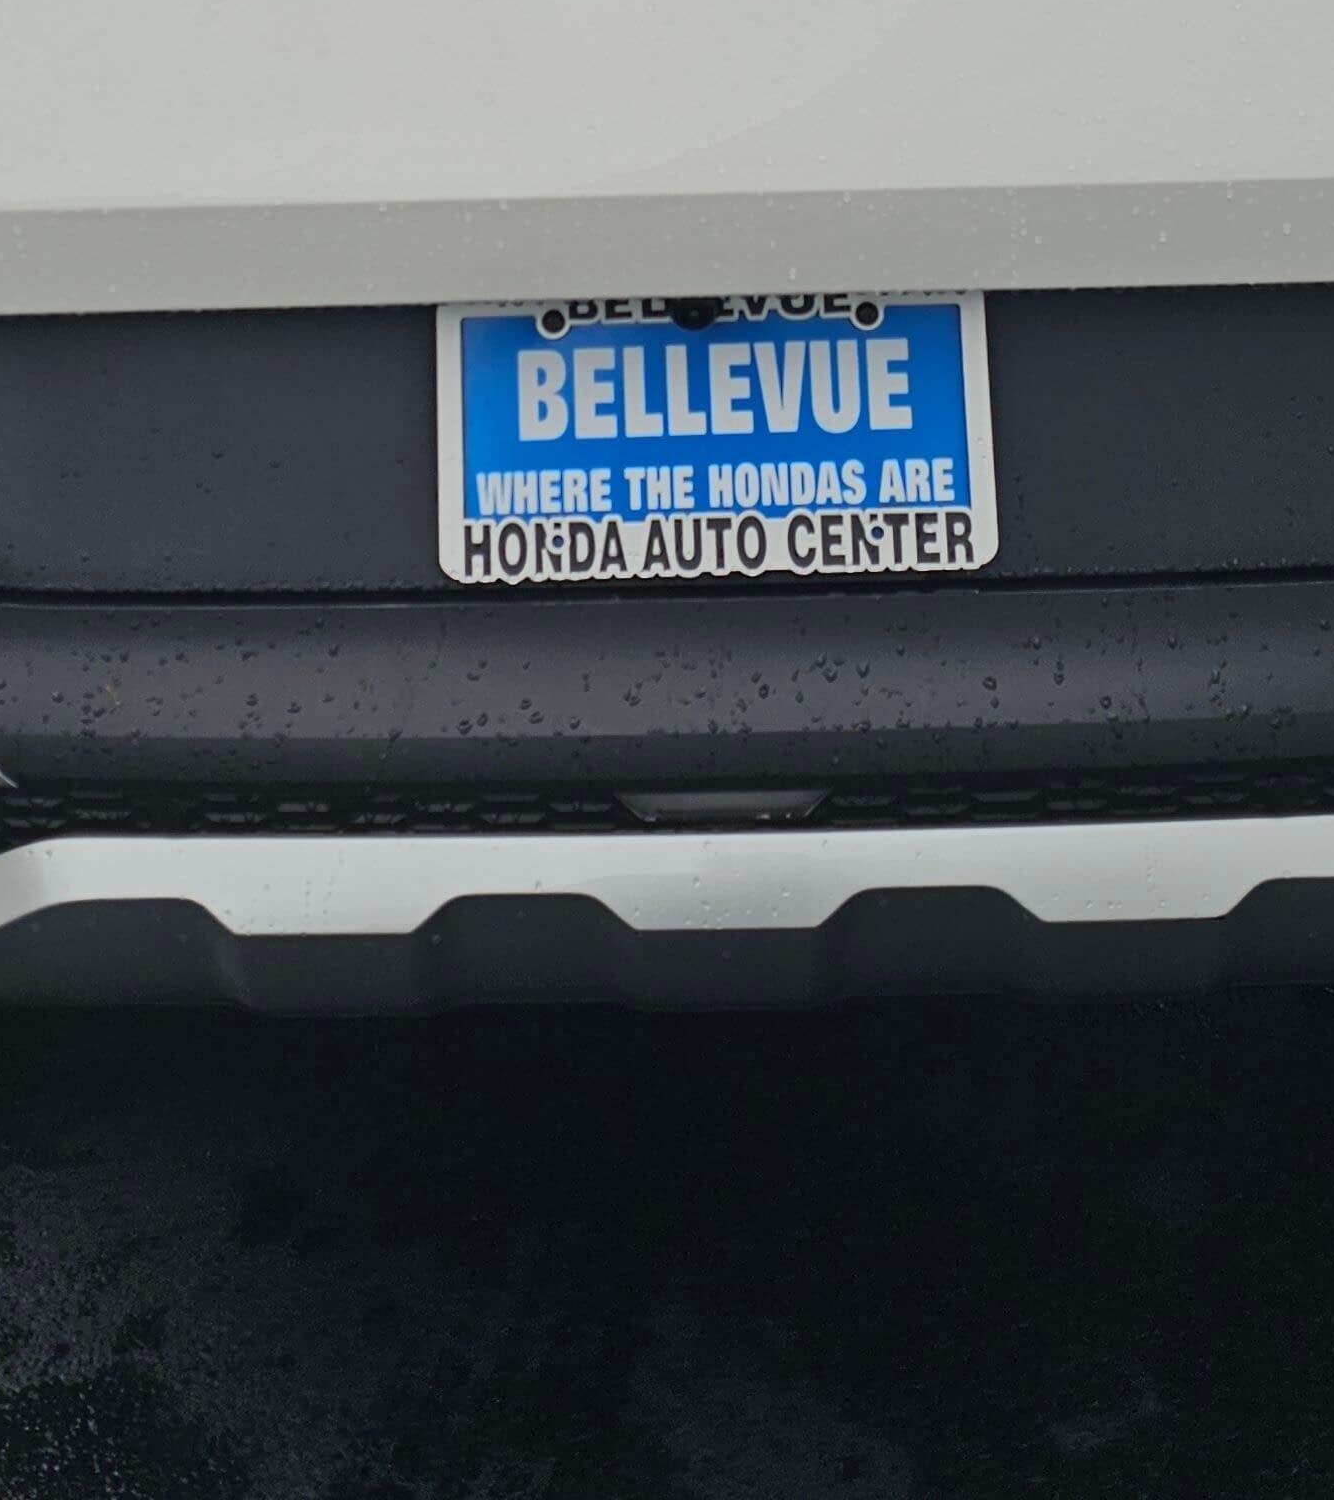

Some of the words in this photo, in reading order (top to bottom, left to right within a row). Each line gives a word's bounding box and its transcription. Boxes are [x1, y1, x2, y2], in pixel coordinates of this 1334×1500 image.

[518, 338, 913, 442] BELLEVUE
[476, 468, 612, 515] WHERE
[624, 464, 695, 510] THE
[708, 458, 867, 508] HONDAS
[879, 457, 955, 503] ARE
[464, 519, 627, 577] HONDA
[643, 515, 767, 573] AUTO
[787, 511, 975, 568] CENTER
